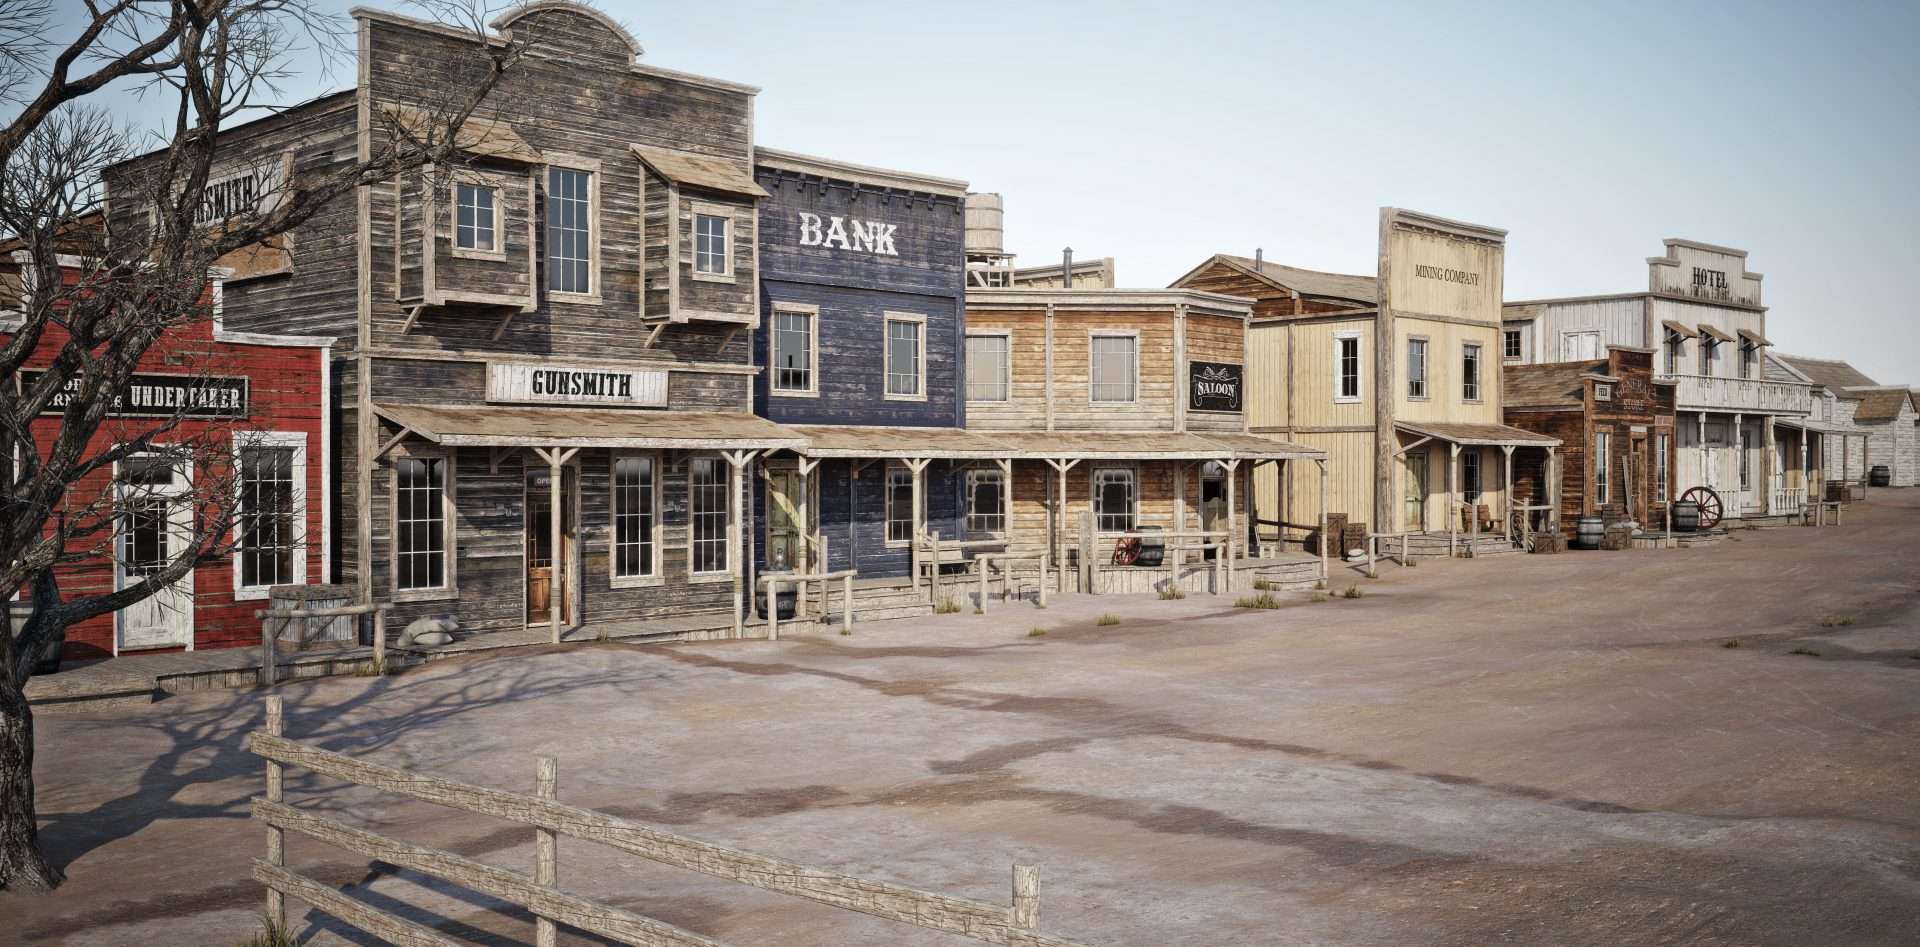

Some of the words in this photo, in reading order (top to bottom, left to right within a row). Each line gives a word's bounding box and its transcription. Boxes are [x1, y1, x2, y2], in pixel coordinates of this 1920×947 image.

[799, 212, 898, 256] BANK
[1415, 264, 1443, 280] MINING
[1444, 268, 1479, 286] COMPANY
[1693, 266, 1728, 289] HOTEL
[532, 370, 632, 396] GUNSMITH
[1197, 381, 1236, 398] SALOON
[131, 385, 240, 409] UNDERTAKER
